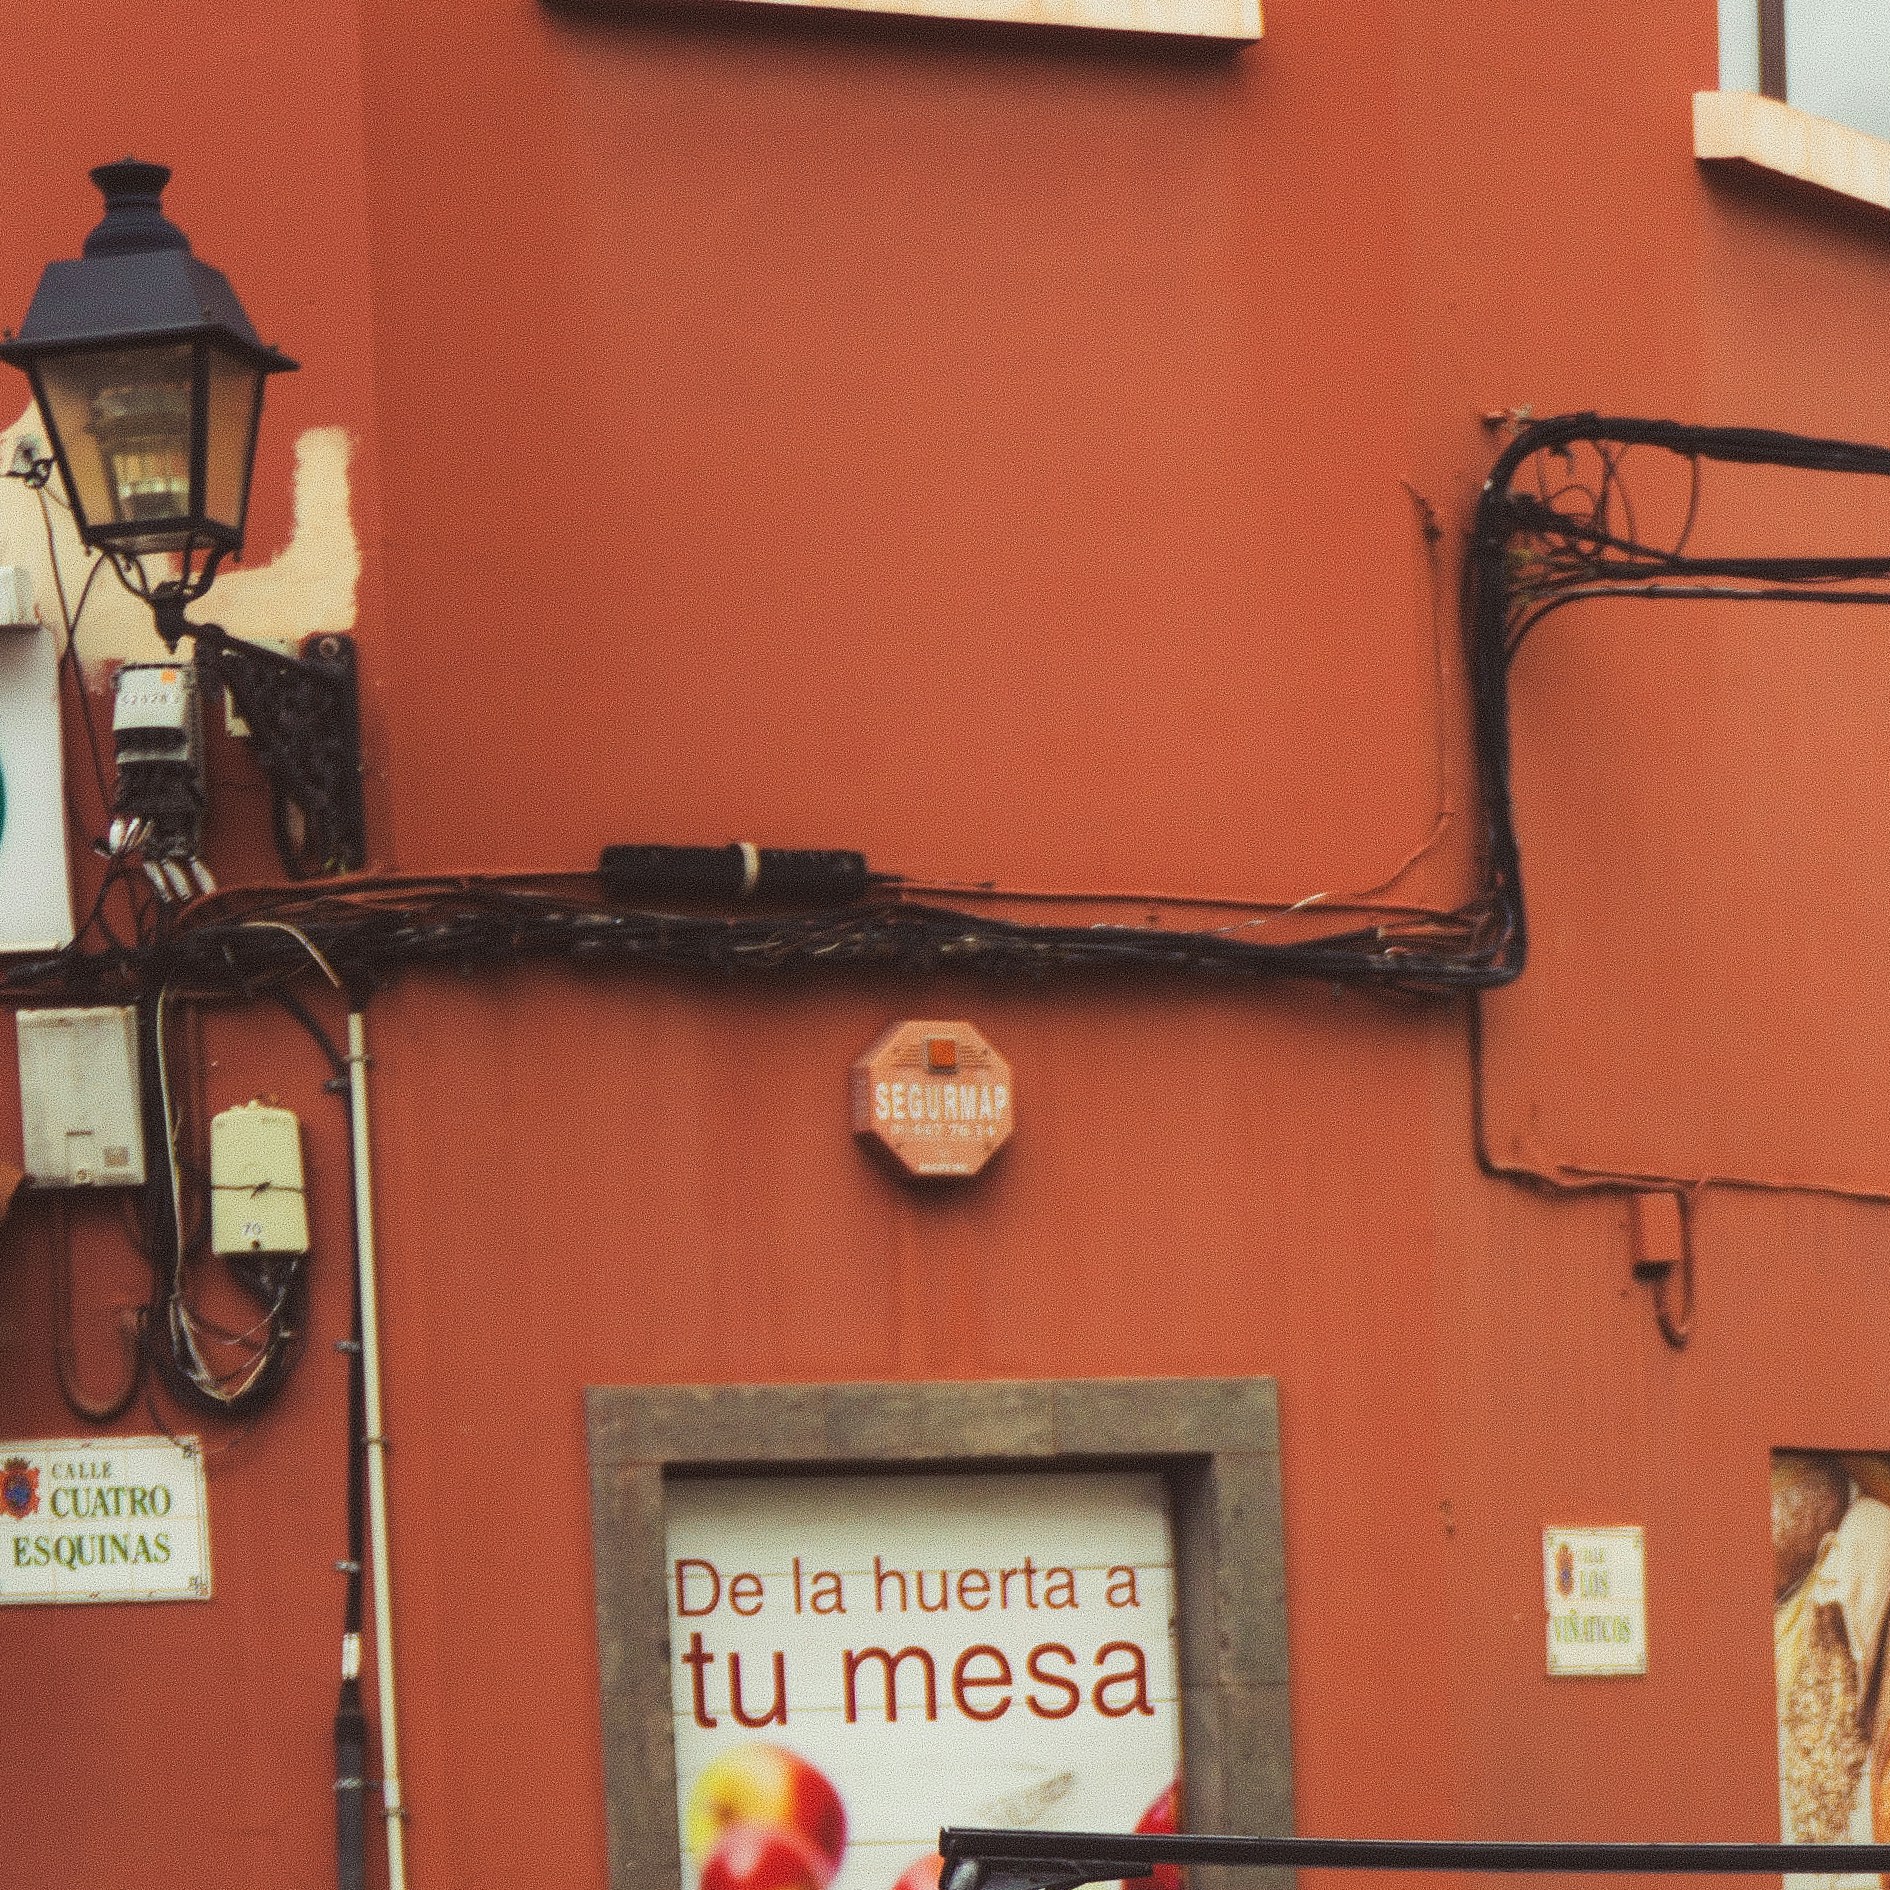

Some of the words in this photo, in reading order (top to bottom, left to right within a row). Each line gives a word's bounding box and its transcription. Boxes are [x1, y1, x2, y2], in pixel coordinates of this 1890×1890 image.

[51, 1460, 112, 1480] CALLE
[50, 1484, 172, 1518] CUATRO
[13, 1532, 172, 1572] ESQUINAS
[674, 1558, 763, 1618] De
[792, 1556, 847, 1615] la
[873, 1555, 1080, 1613] huerta
[1105, 1564, 1141, 1609] a
[681, 1631, 787, 1728] tu
[842, 1639, 1156, 1724] mesa
